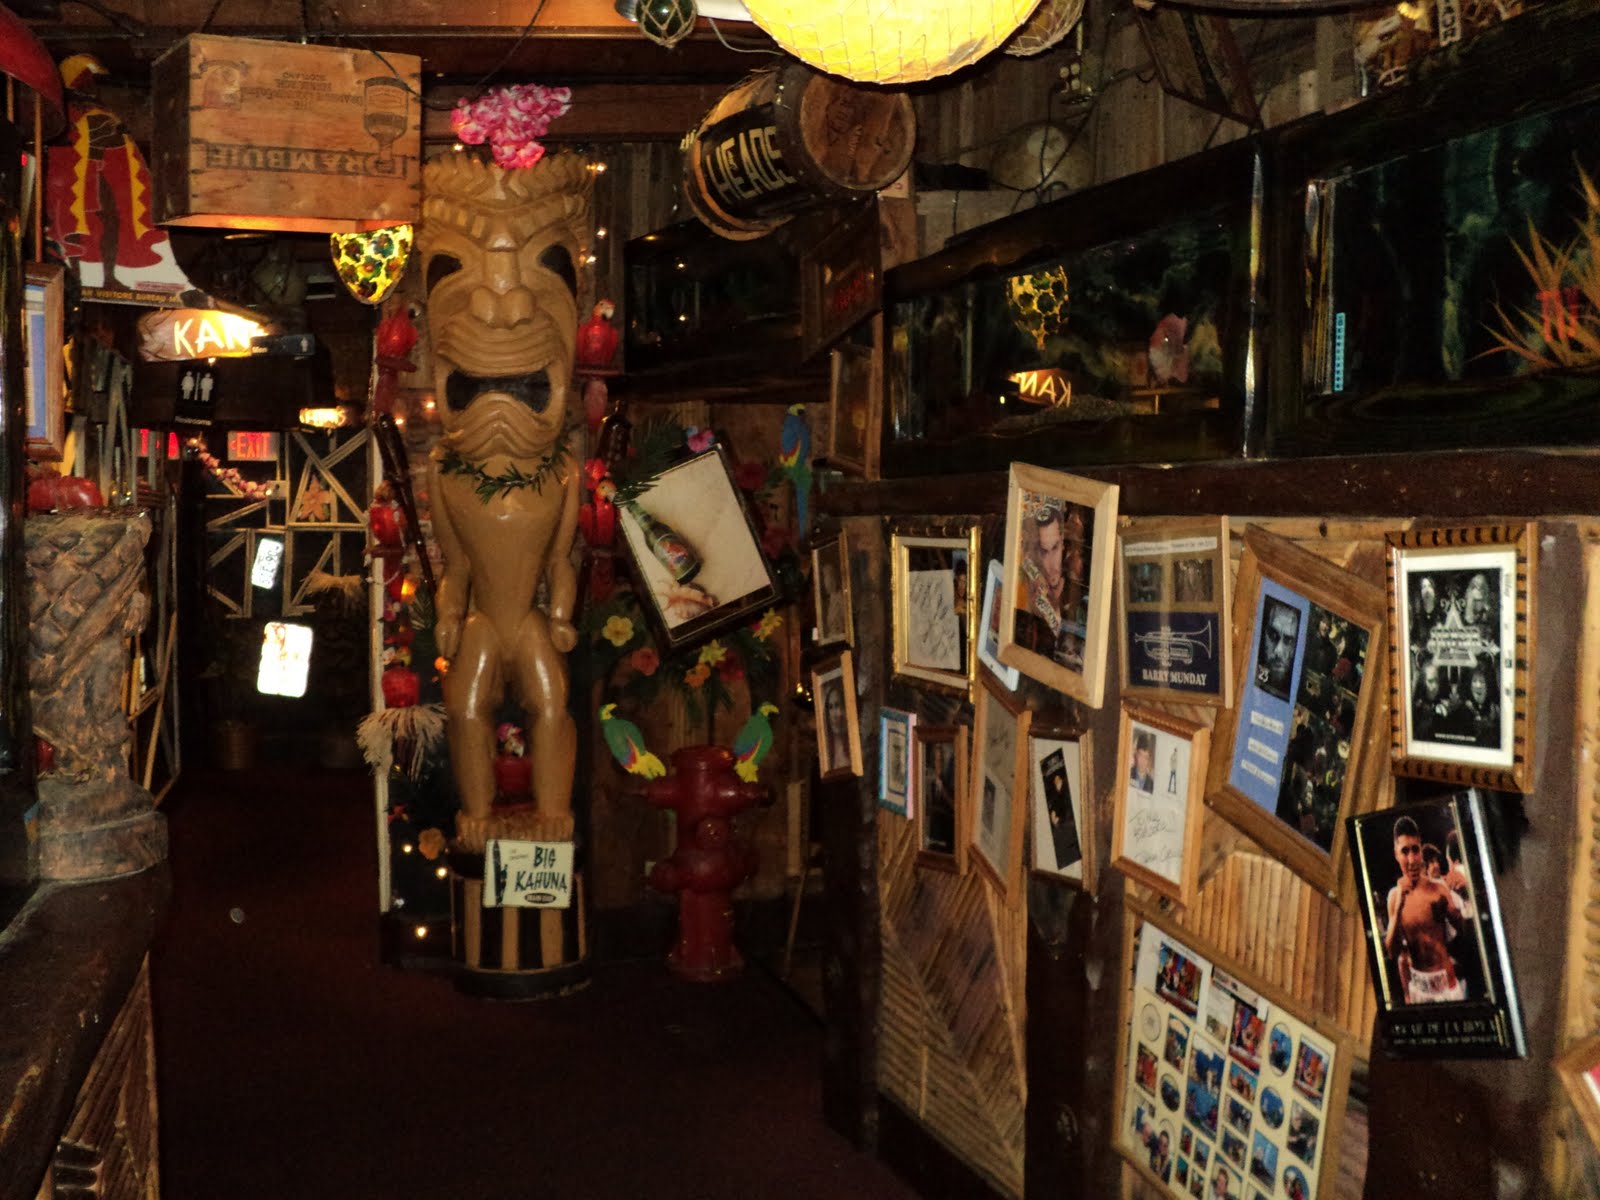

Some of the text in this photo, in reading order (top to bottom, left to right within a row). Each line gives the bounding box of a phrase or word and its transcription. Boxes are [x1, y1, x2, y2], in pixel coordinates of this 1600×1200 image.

[1142, 668, 1208, 687] BARRY MUNDAY
[533, 845, 557, 869] BIG
[514, 870, 568, 893] KAHUNA
